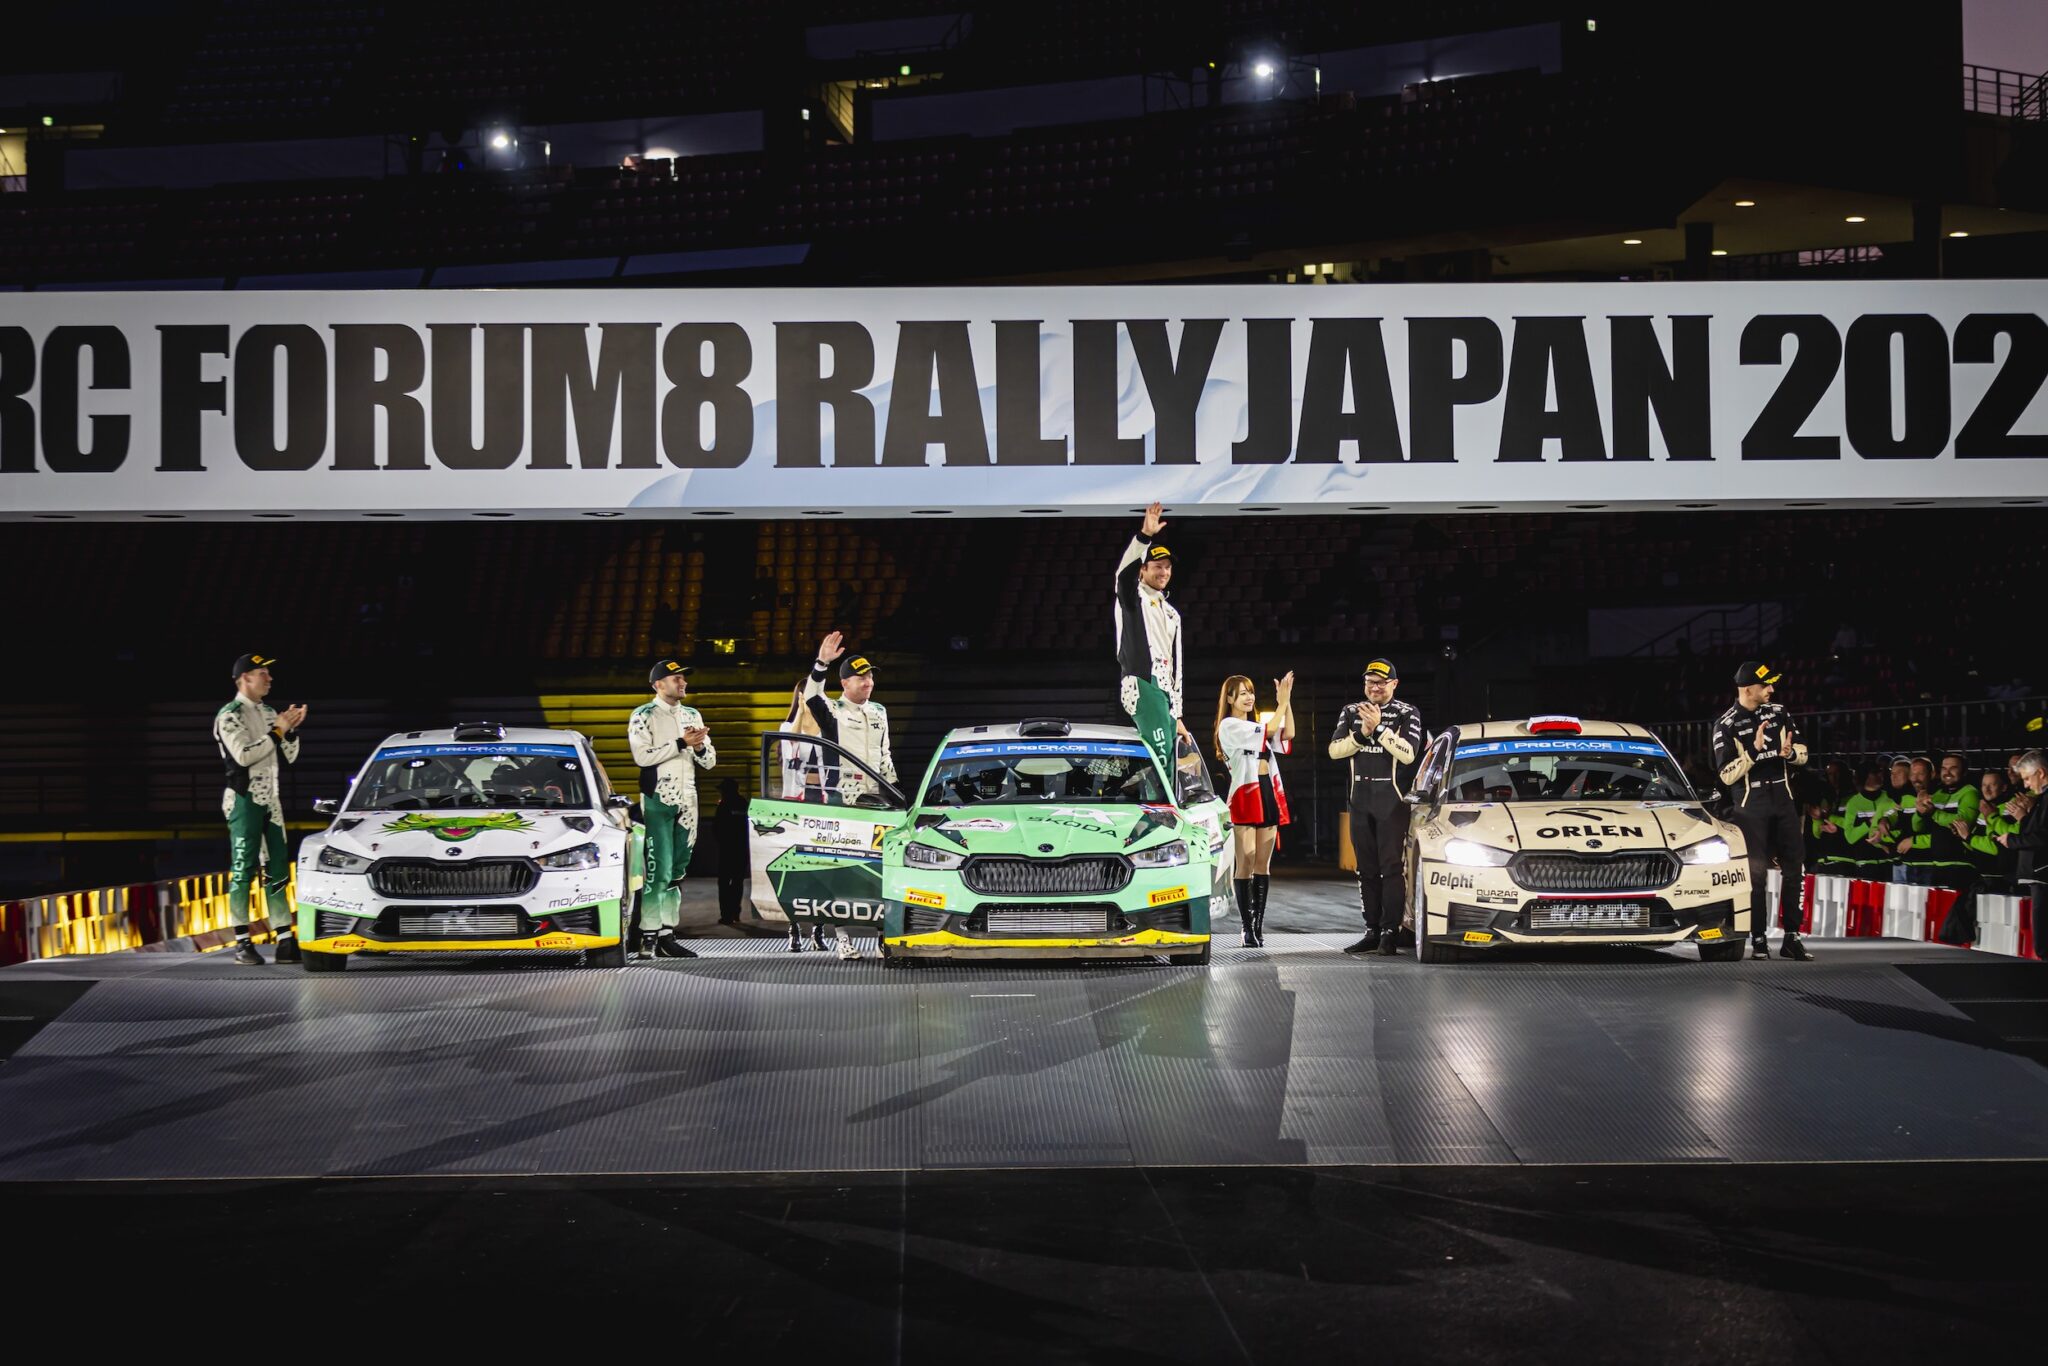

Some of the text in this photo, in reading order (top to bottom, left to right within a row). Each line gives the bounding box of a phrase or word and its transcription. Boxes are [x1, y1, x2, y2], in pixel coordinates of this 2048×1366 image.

[155, 322, 754, 472] FORUM8
[773, 319, 1229, 468] RALLY
[1231, 316, 1716, 464] JAPAN
[1739, 313, 2048, 462] 202
[1536, 825, 1643, 838] ORLEN
[1430, 871, 1474, 889] Delphi
[1712, 868, 1746, 886] Delphi
[1152, 888, 1184, 903] PIRELLI
